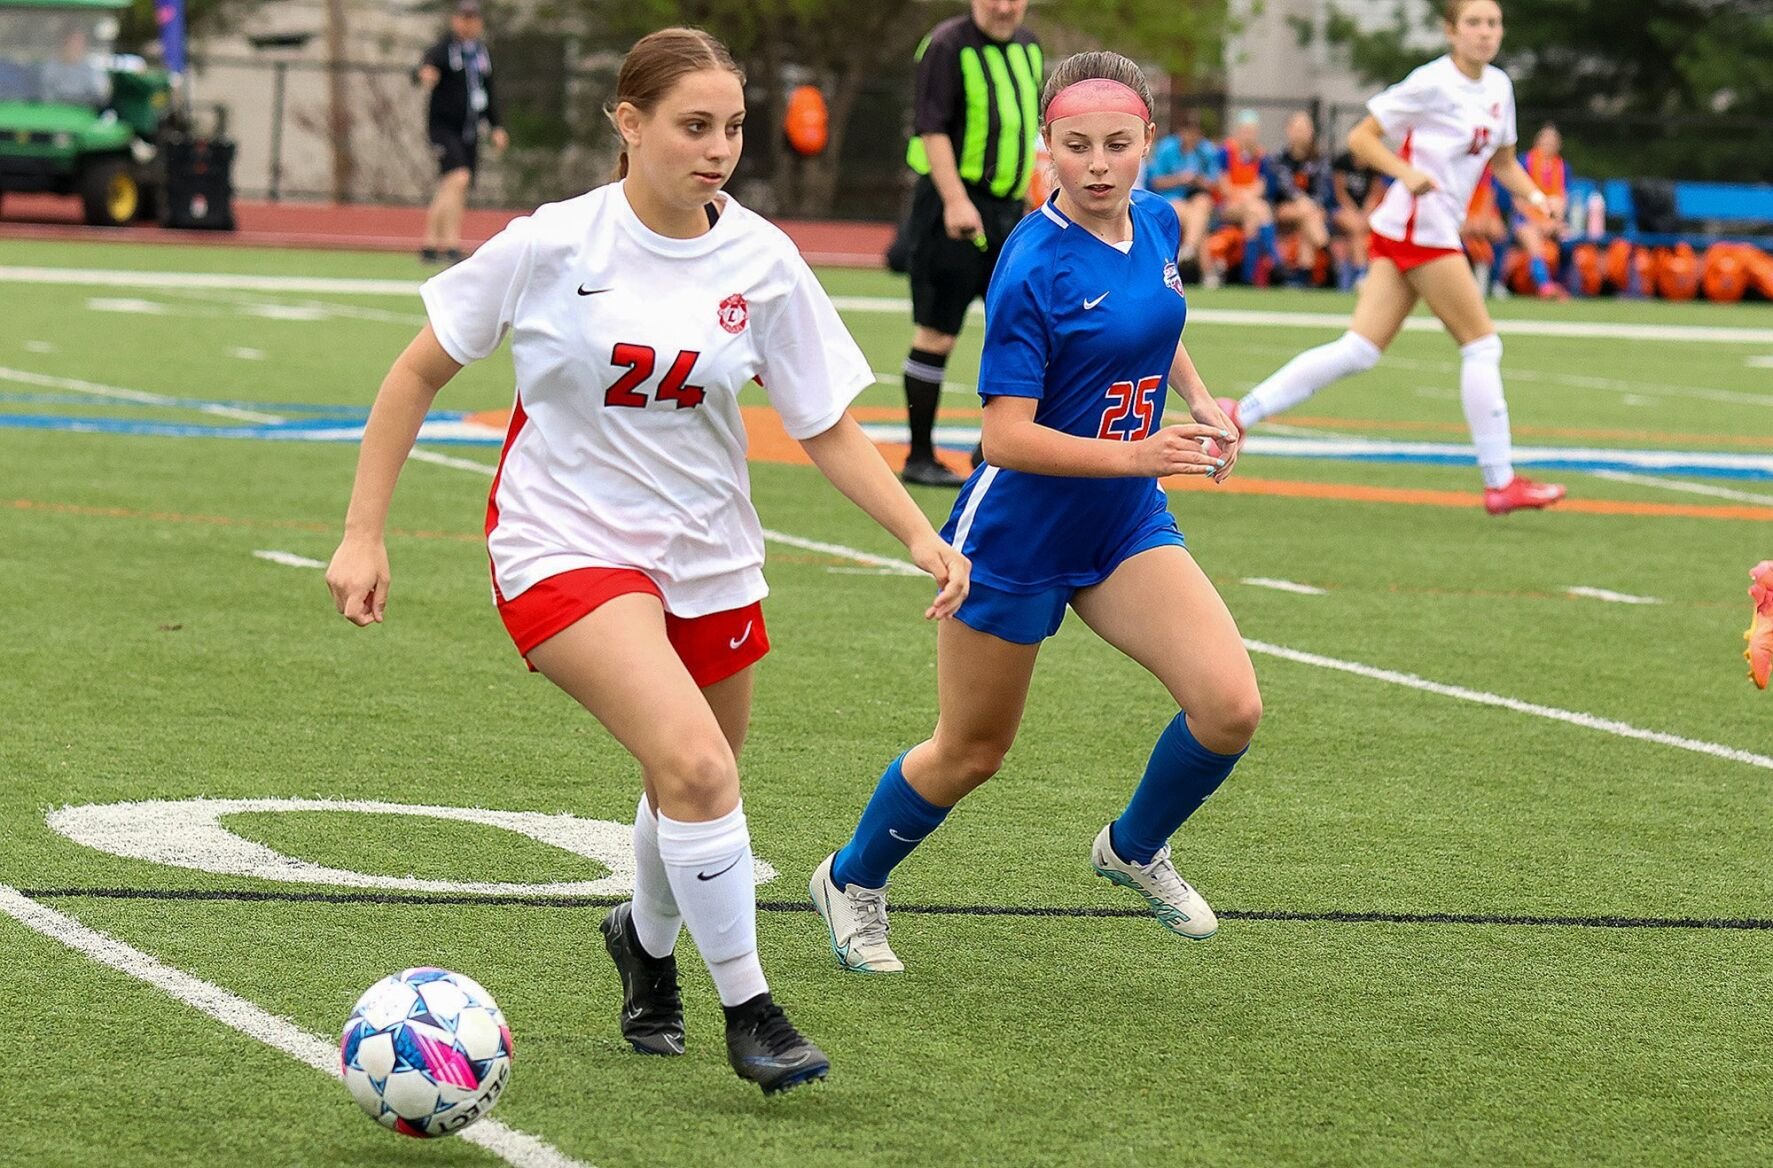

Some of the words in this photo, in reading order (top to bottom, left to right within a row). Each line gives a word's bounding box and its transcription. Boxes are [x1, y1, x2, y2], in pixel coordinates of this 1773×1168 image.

[727, 310, 737, 322] L
[604, 342, 706, 409] 24
[1096, 375, 1163, 441] 25
[438, 1064, 508, 1133] SELECT
